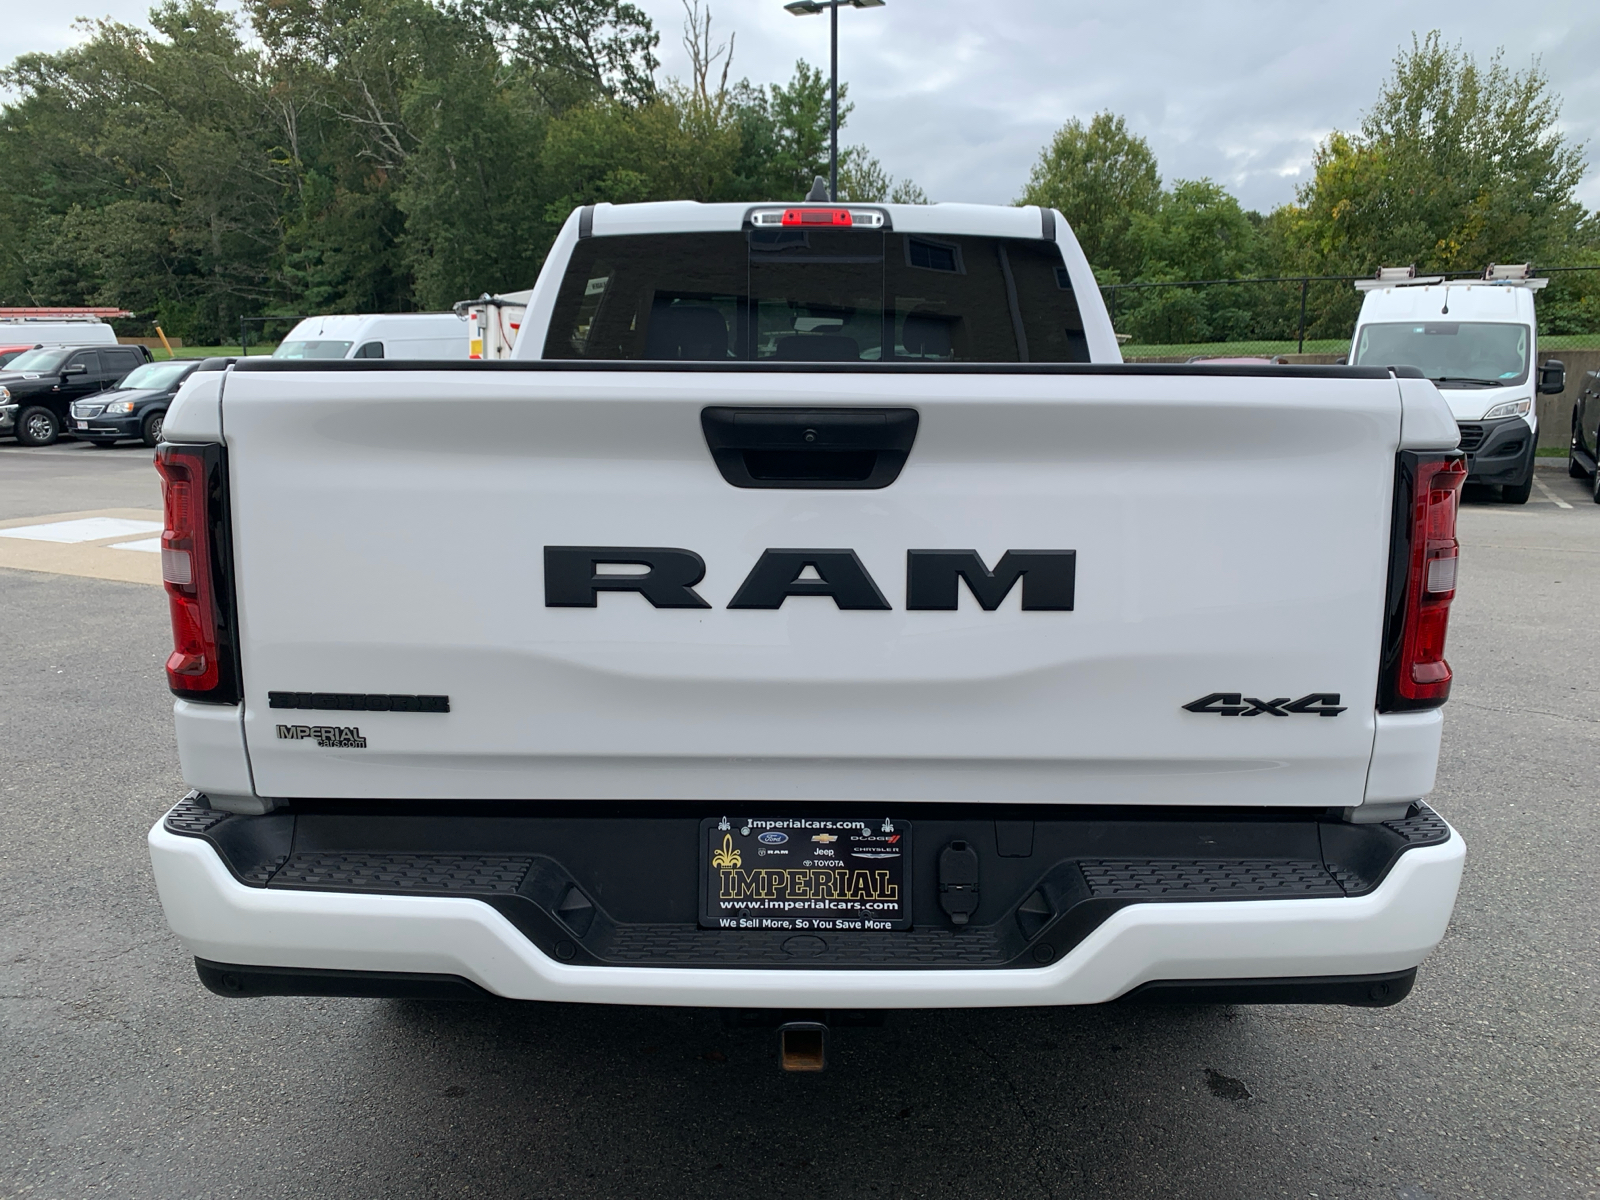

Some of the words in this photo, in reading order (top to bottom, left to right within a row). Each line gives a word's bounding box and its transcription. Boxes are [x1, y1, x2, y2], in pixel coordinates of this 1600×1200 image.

[544, 545, 1076, 611] RAM
[276, 724, 366, 741] IMPERIAL
[317, 738, 367, 748] cars.com
[747, 819, 865, 829] Imperialcars.com
[764, 834, 782, 842] Ford
[814, 848, 835, 856] Jeep
[719, 869, 898, 900] IMPERIAL
[720, 899, 899, 911] www.imperialcars.com
[720, 919, 737, 928] We
[739, 918, 759, 928] Sell
[762, 919, 792, 930] More,
[795, 919, 809, 929] So
[812, 919, 833, 929] You
[835, 920, 862, 929] Save
[864, 920, 892, 930] More
